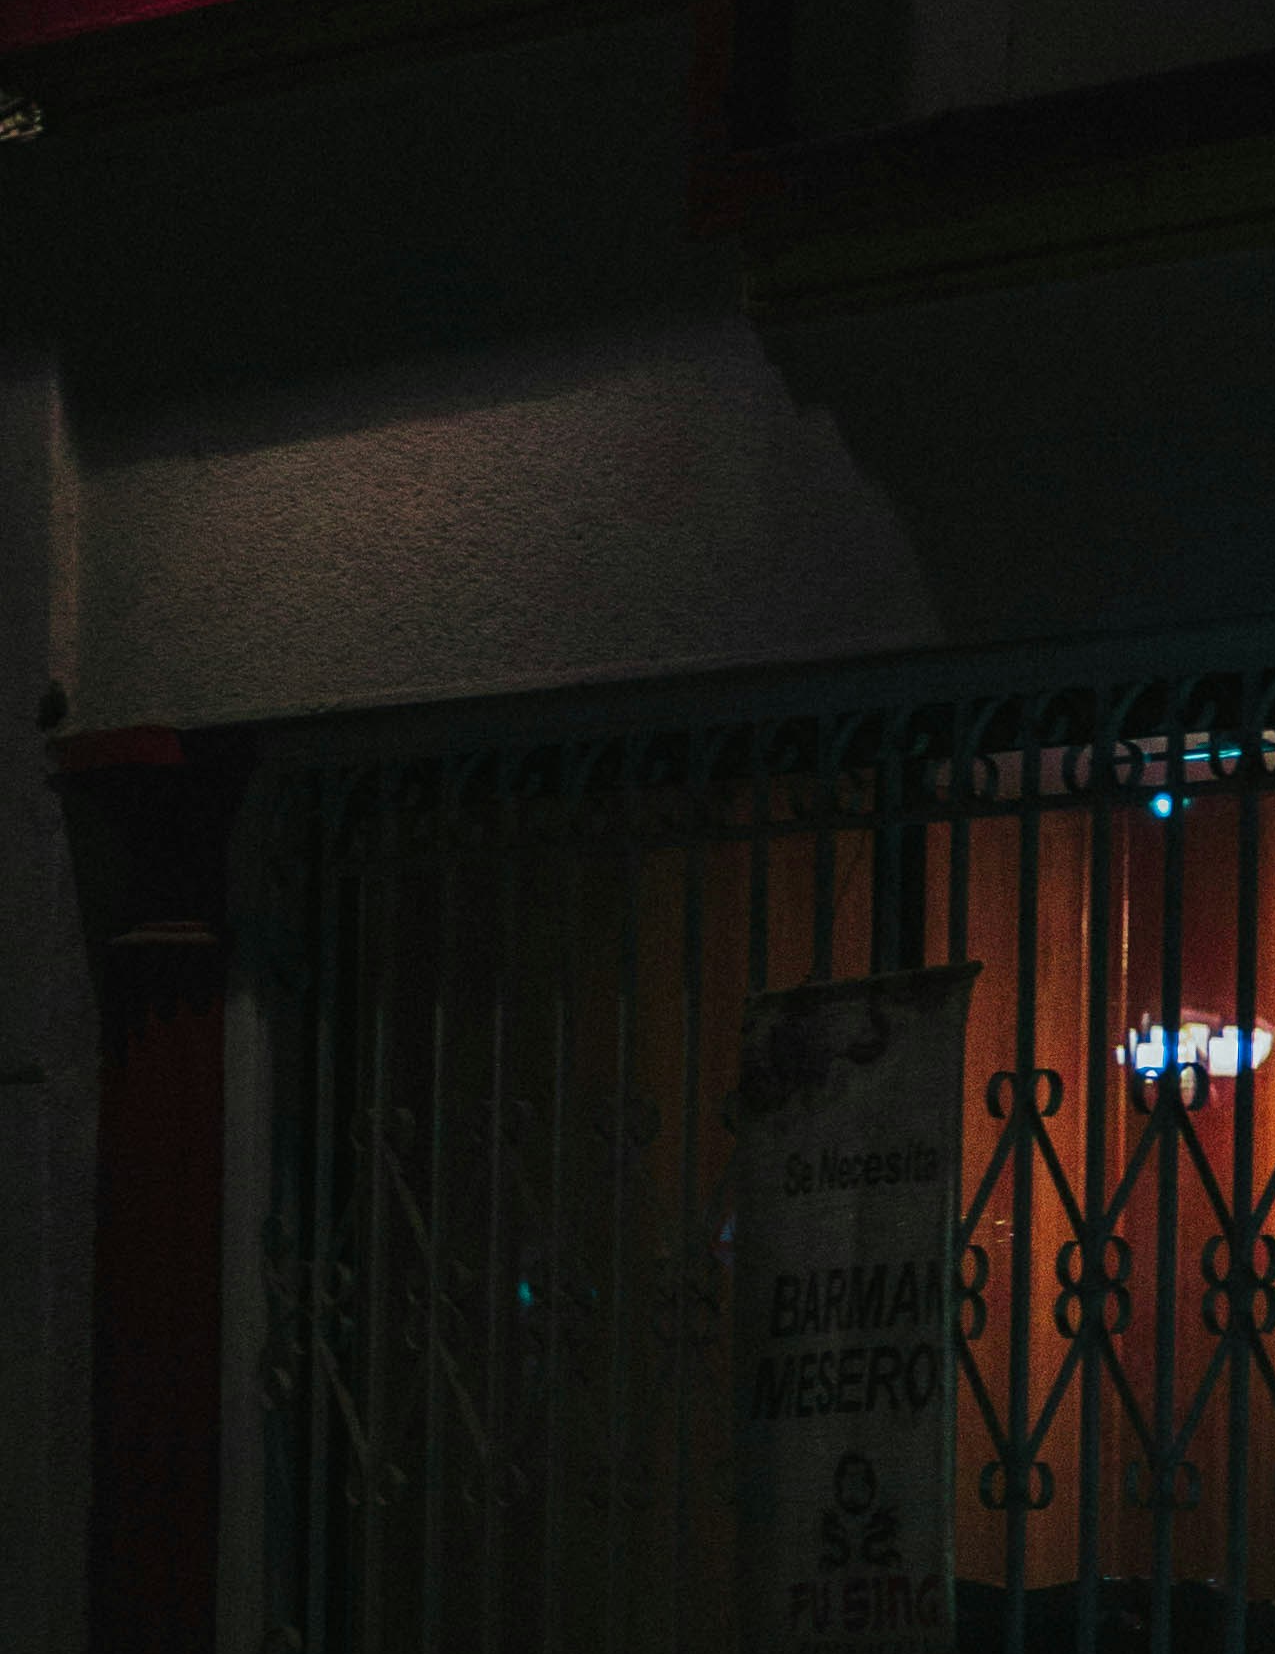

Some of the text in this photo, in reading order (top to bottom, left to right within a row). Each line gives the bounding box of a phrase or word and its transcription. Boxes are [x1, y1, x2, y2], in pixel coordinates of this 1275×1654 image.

[783, 1144, 938, 1196] Se Necesita
[751, 1342, 943, 1420] MESERO
